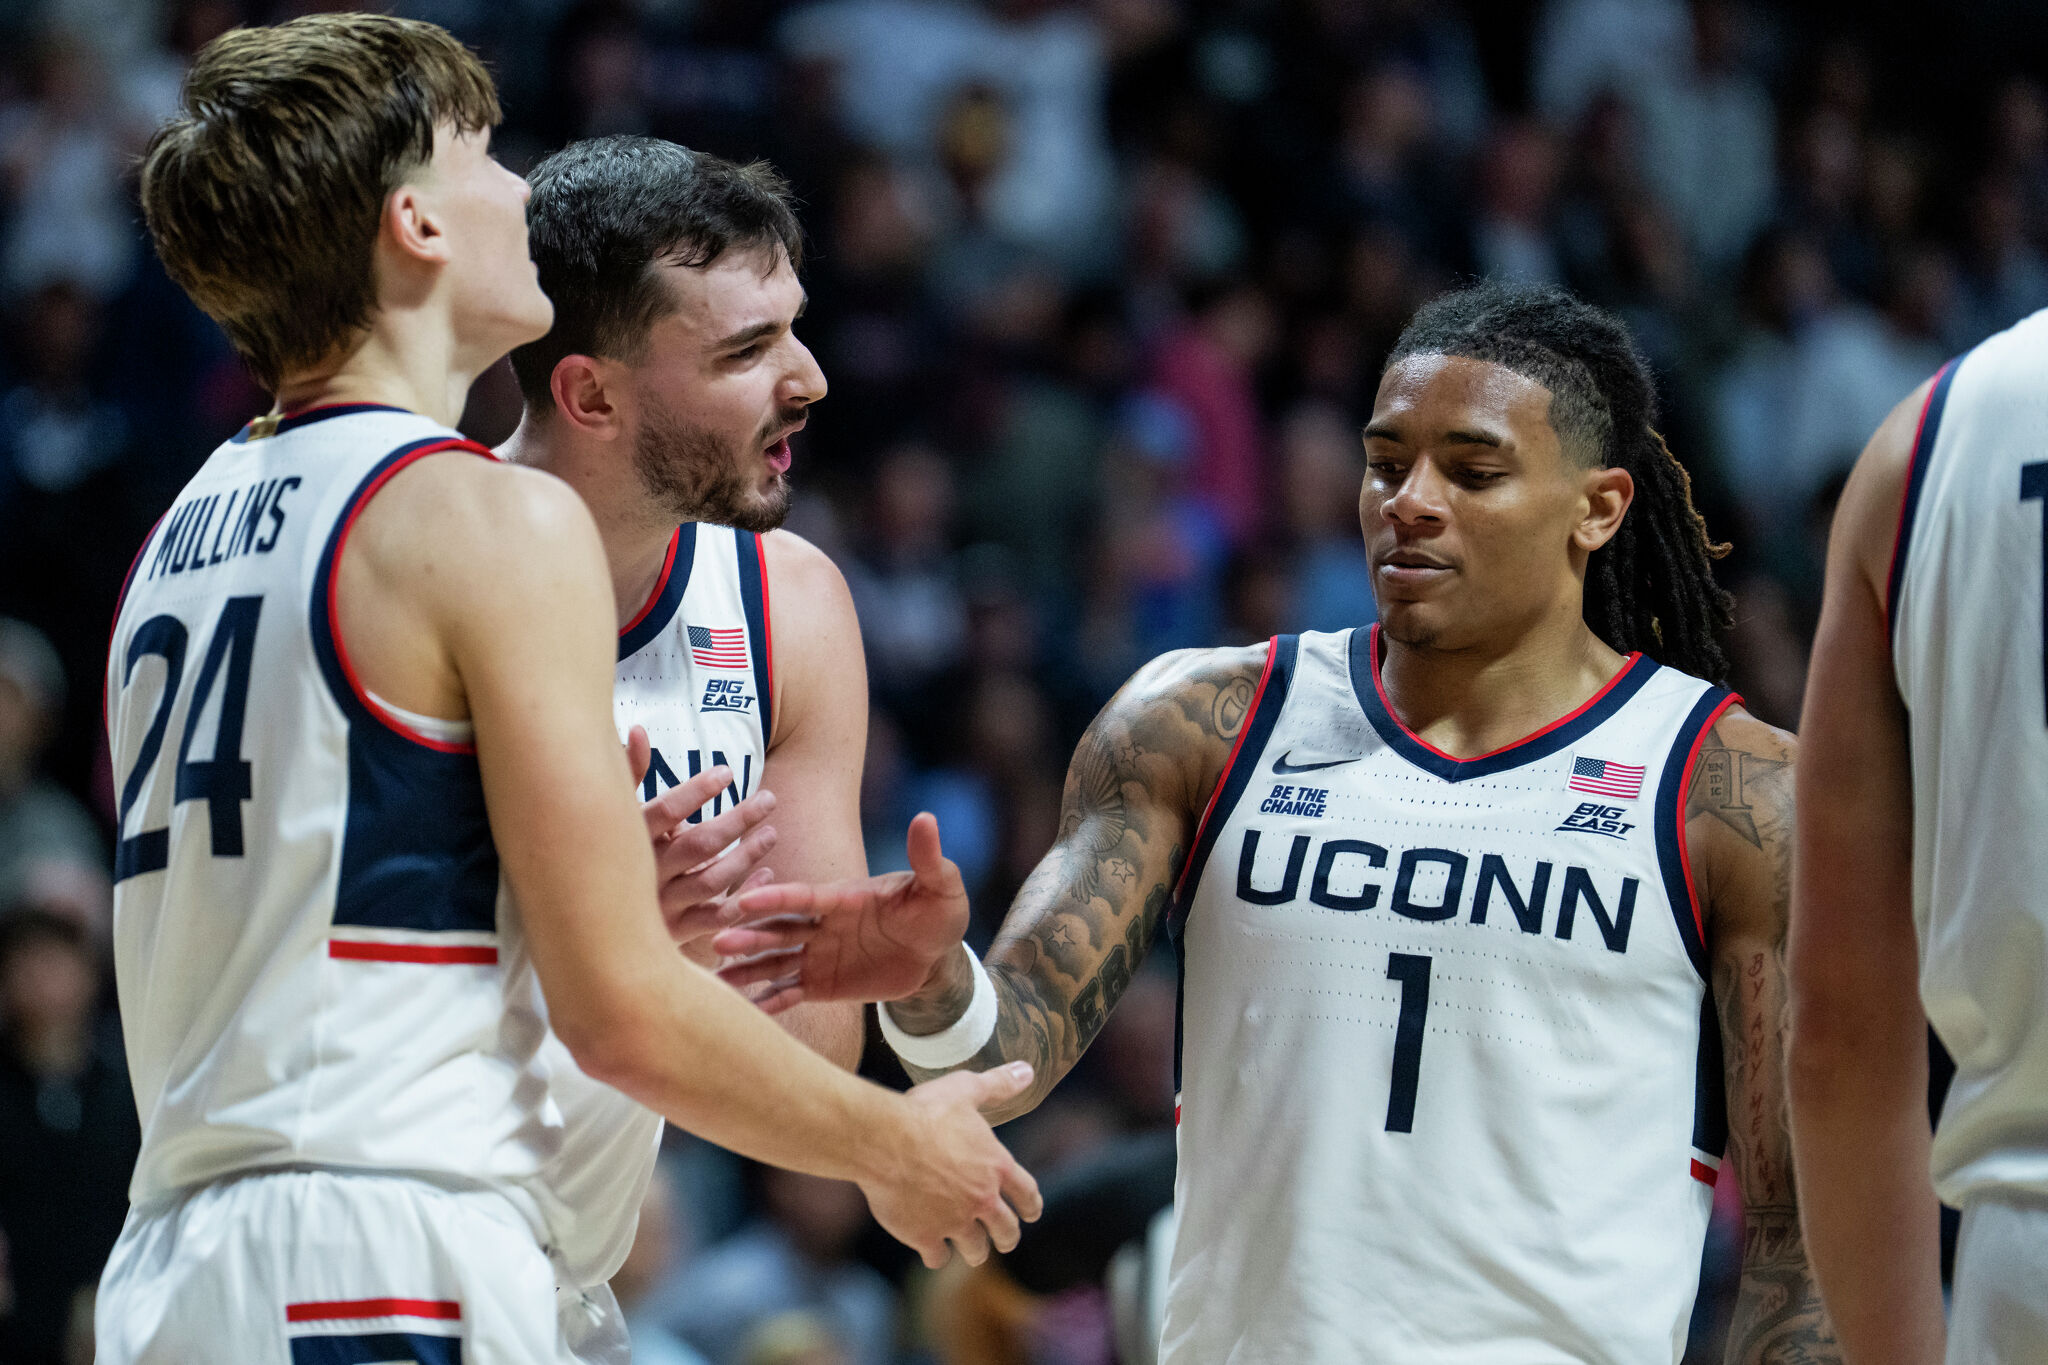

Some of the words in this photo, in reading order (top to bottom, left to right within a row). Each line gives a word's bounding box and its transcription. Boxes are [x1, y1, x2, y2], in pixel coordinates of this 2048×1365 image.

[149, 477, 302, 581] MULLINS
[705, 679, 745, 694] BIG
[702, 693, 755, 708] EAST
[114, 594, 264, 886] 24
[1270, 785, 1294, 799] BE
[1297, 787, 1329, 803] THE
[1260, 799, 1327, 818] CHANGE
[1573, 802, 1627, 820] BIG
[1562, 815, 1636, 834] EAST
[1236, 829, 1640, 953] UCONN
[1384, 952, 1433, 1133] 1
